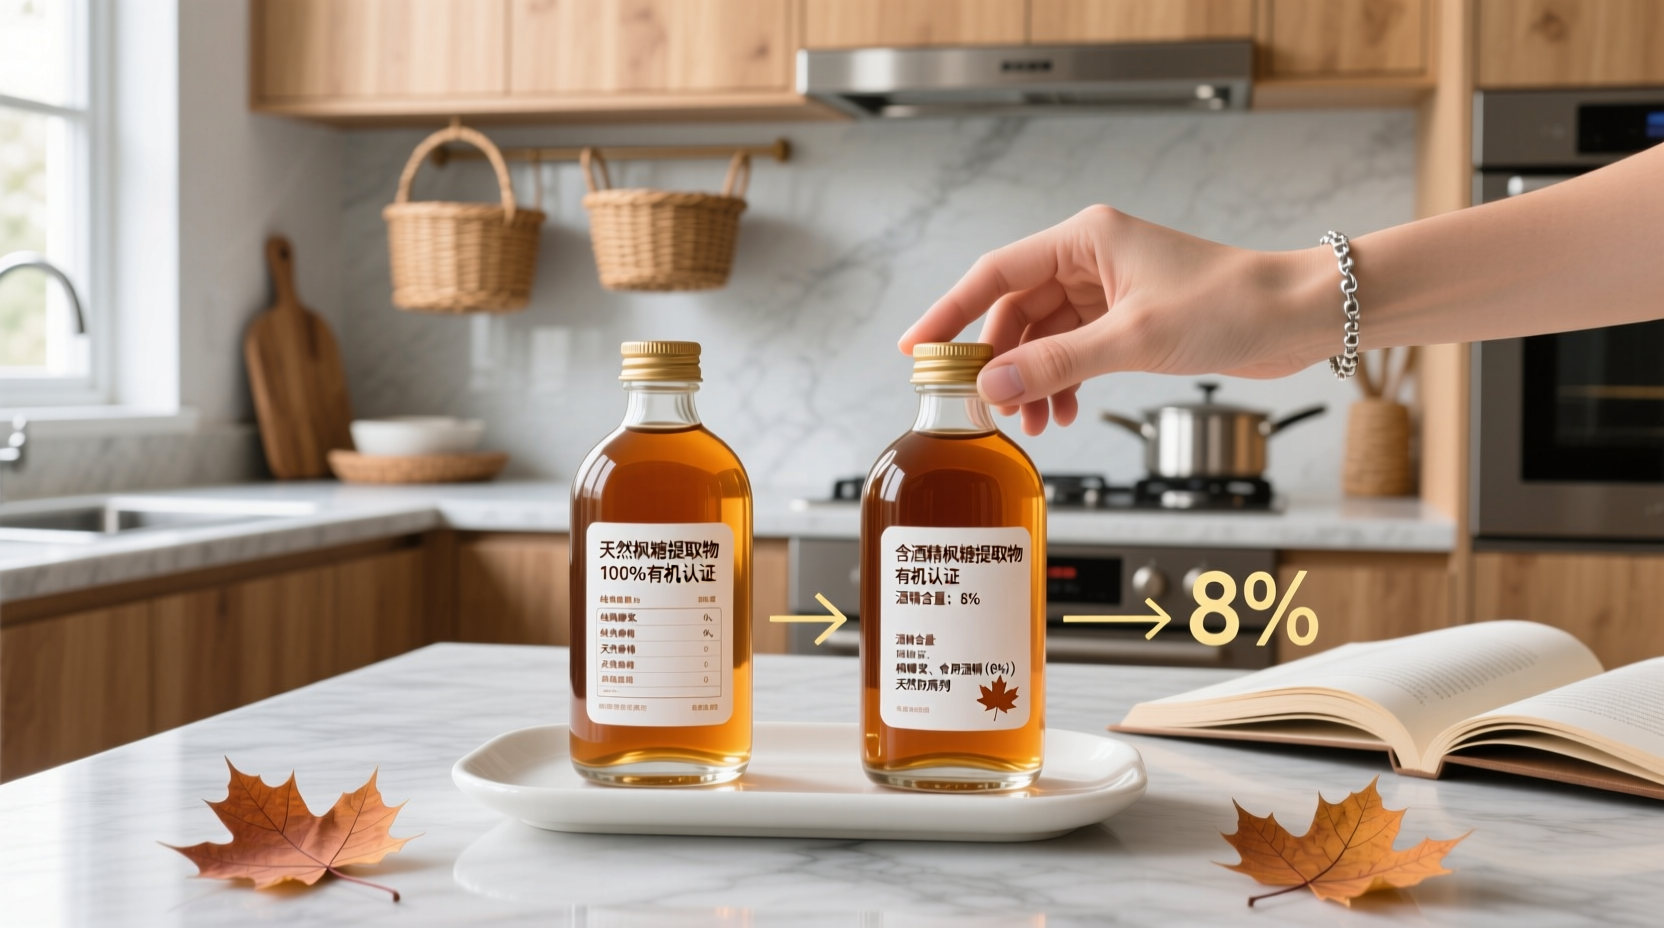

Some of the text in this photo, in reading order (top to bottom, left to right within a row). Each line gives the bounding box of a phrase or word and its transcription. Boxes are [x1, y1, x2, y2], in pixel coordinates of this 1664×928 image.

[895, 543, 1023, 564] 含酒精枫糖提取物
[600, 563, 716, 584] 100%有机认证
[895, 567, 960, 585] 有机认证
